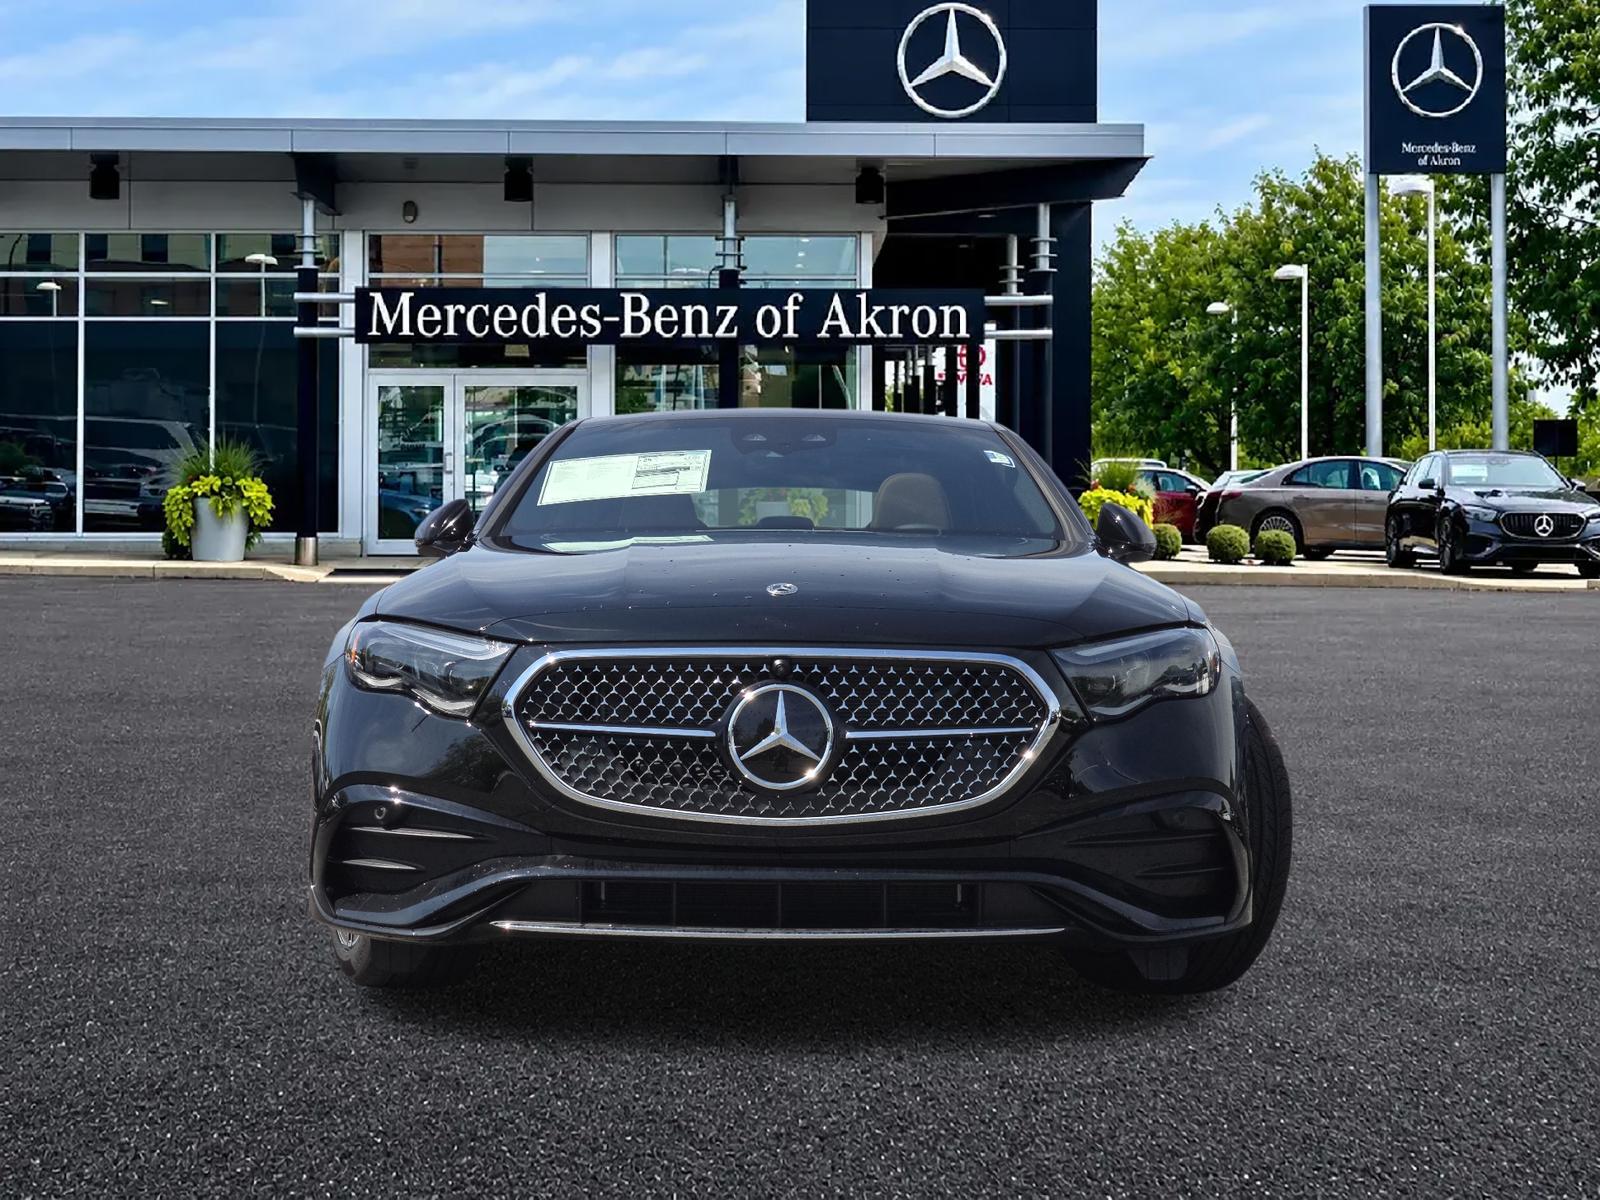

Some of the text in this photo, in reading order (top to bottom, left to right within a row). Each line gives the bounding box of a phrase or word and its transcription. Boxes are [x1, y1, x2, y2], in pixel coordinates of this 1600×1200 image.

[1401, 141, 1477, 154] Mercedes-Benz
[1417, 154, 1461, 166] of Akron
[367, 290, 971, 340] Mercedes-Benz of Akron
